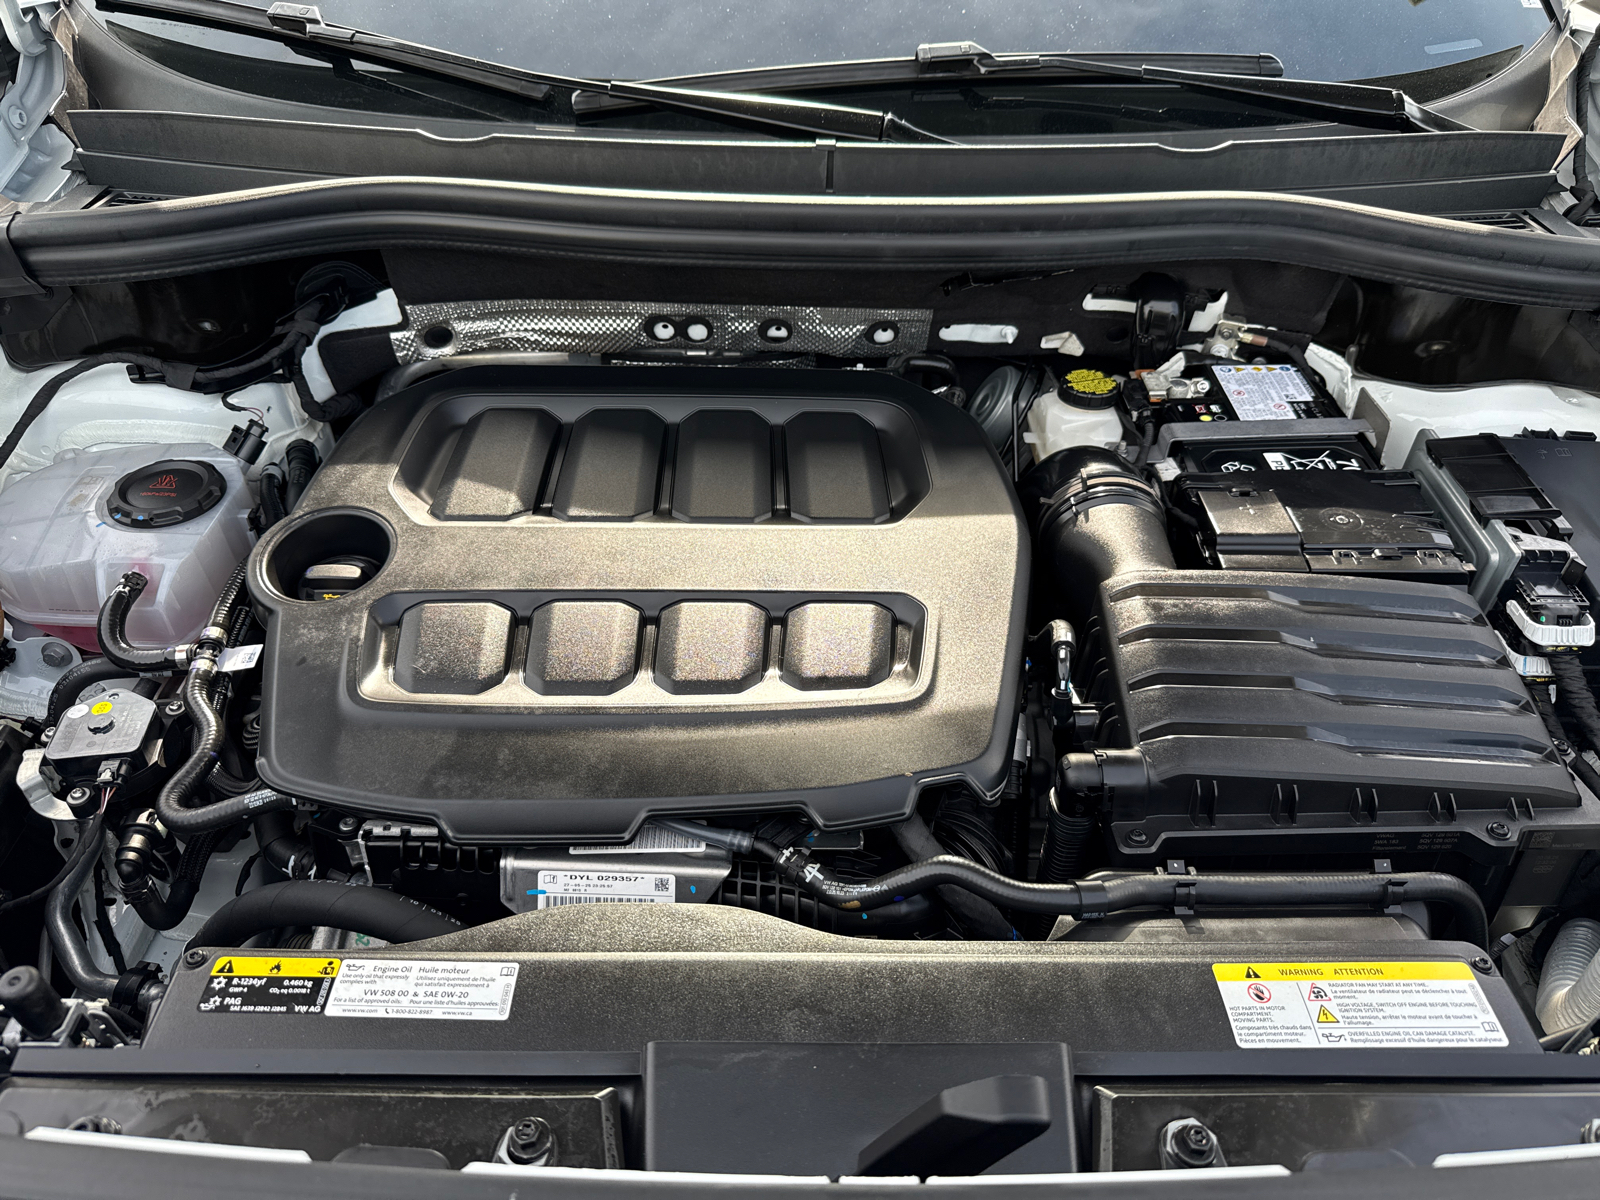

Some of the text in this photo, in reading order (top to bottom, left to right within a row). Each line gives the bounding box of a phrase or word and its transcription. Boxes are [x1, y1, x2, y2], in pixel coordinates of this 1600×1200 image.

[373, 965, 399, 973] Engine
[400, 965, 413, 973] Oil
[418, 966, 439, 974] Huile
[1278, 968, 1384, 976] WARNING ATTENTION
[231, 977, 267, 988] R-1234yf
[304, 980, 314, 988] kg
[380, 989, 396, 997] 508
[397, 989, 409, 997] 00
[224, 997, 242, 1005] PAG
[294, 1005, 308, 1013] VW
